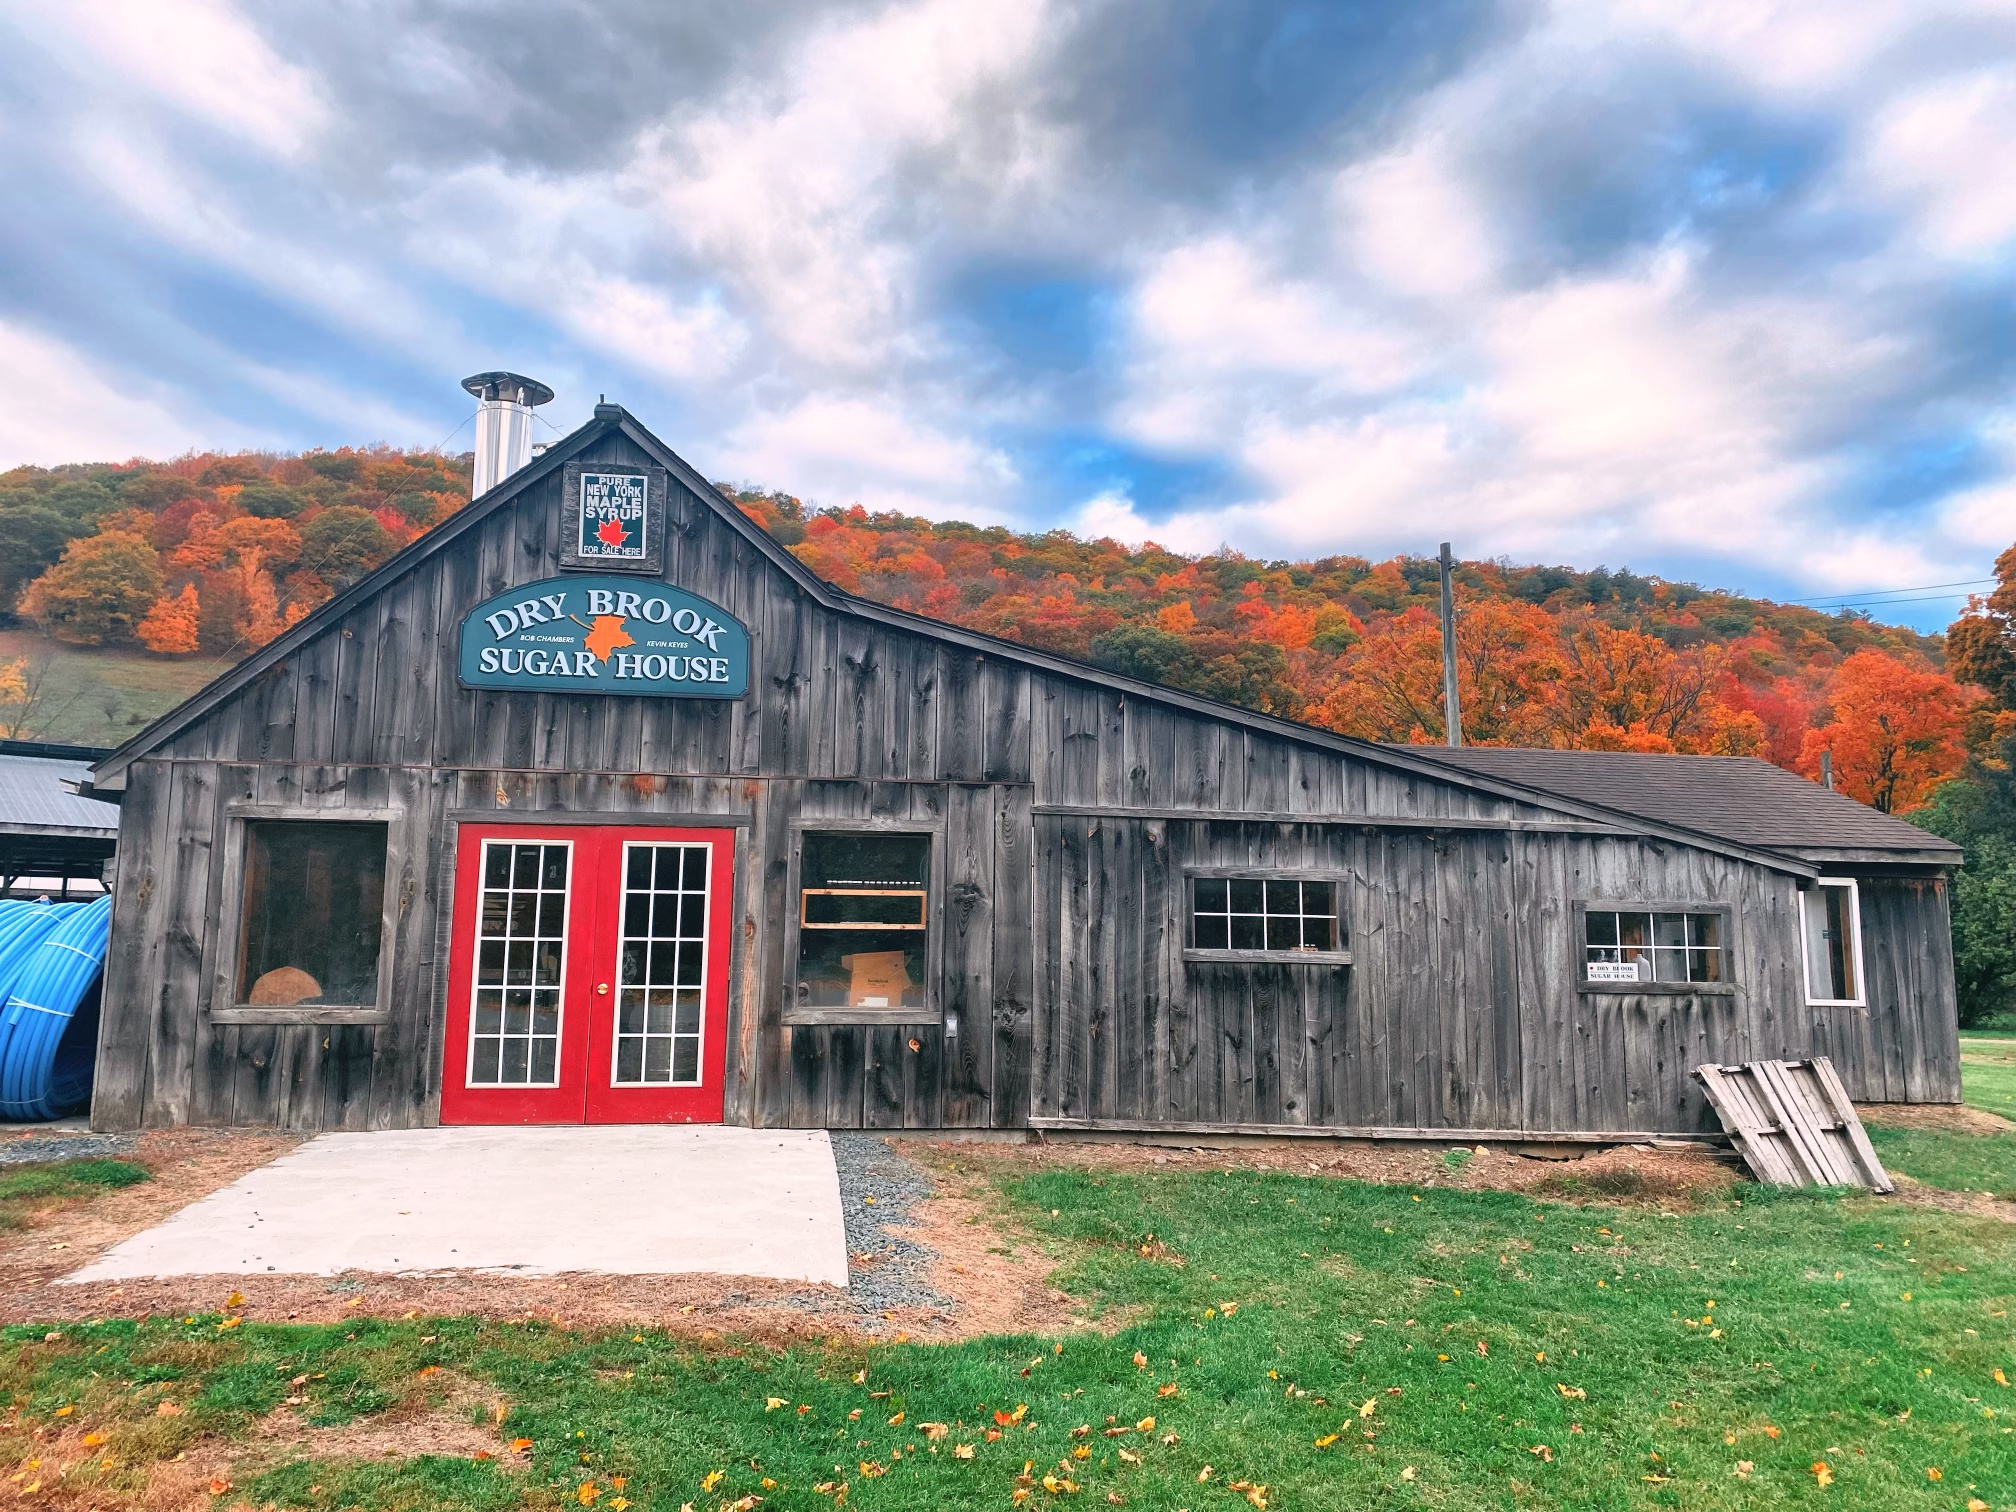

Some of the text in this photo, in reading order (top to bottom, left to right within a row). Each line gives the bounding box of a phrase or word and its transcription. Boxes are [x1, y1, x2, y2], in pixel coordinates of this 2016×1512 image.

[598, 477, 631, 486] PURE
[586, 483, 642, 498] NEW YORK
[586, 495, 642, 509] MAPLE
[585, 506, 643, 520] SYRUP
[583, 545, 641, 556] FOR SALE HERE
[485, 589, 728, 653] DRY BROOK
[520, 634, 575, 643] BOB CHAMBERS
[646, 640, 689, 649] KEVIN KEYES
[480, 647, 730, 682] SUGAR HOUSE
